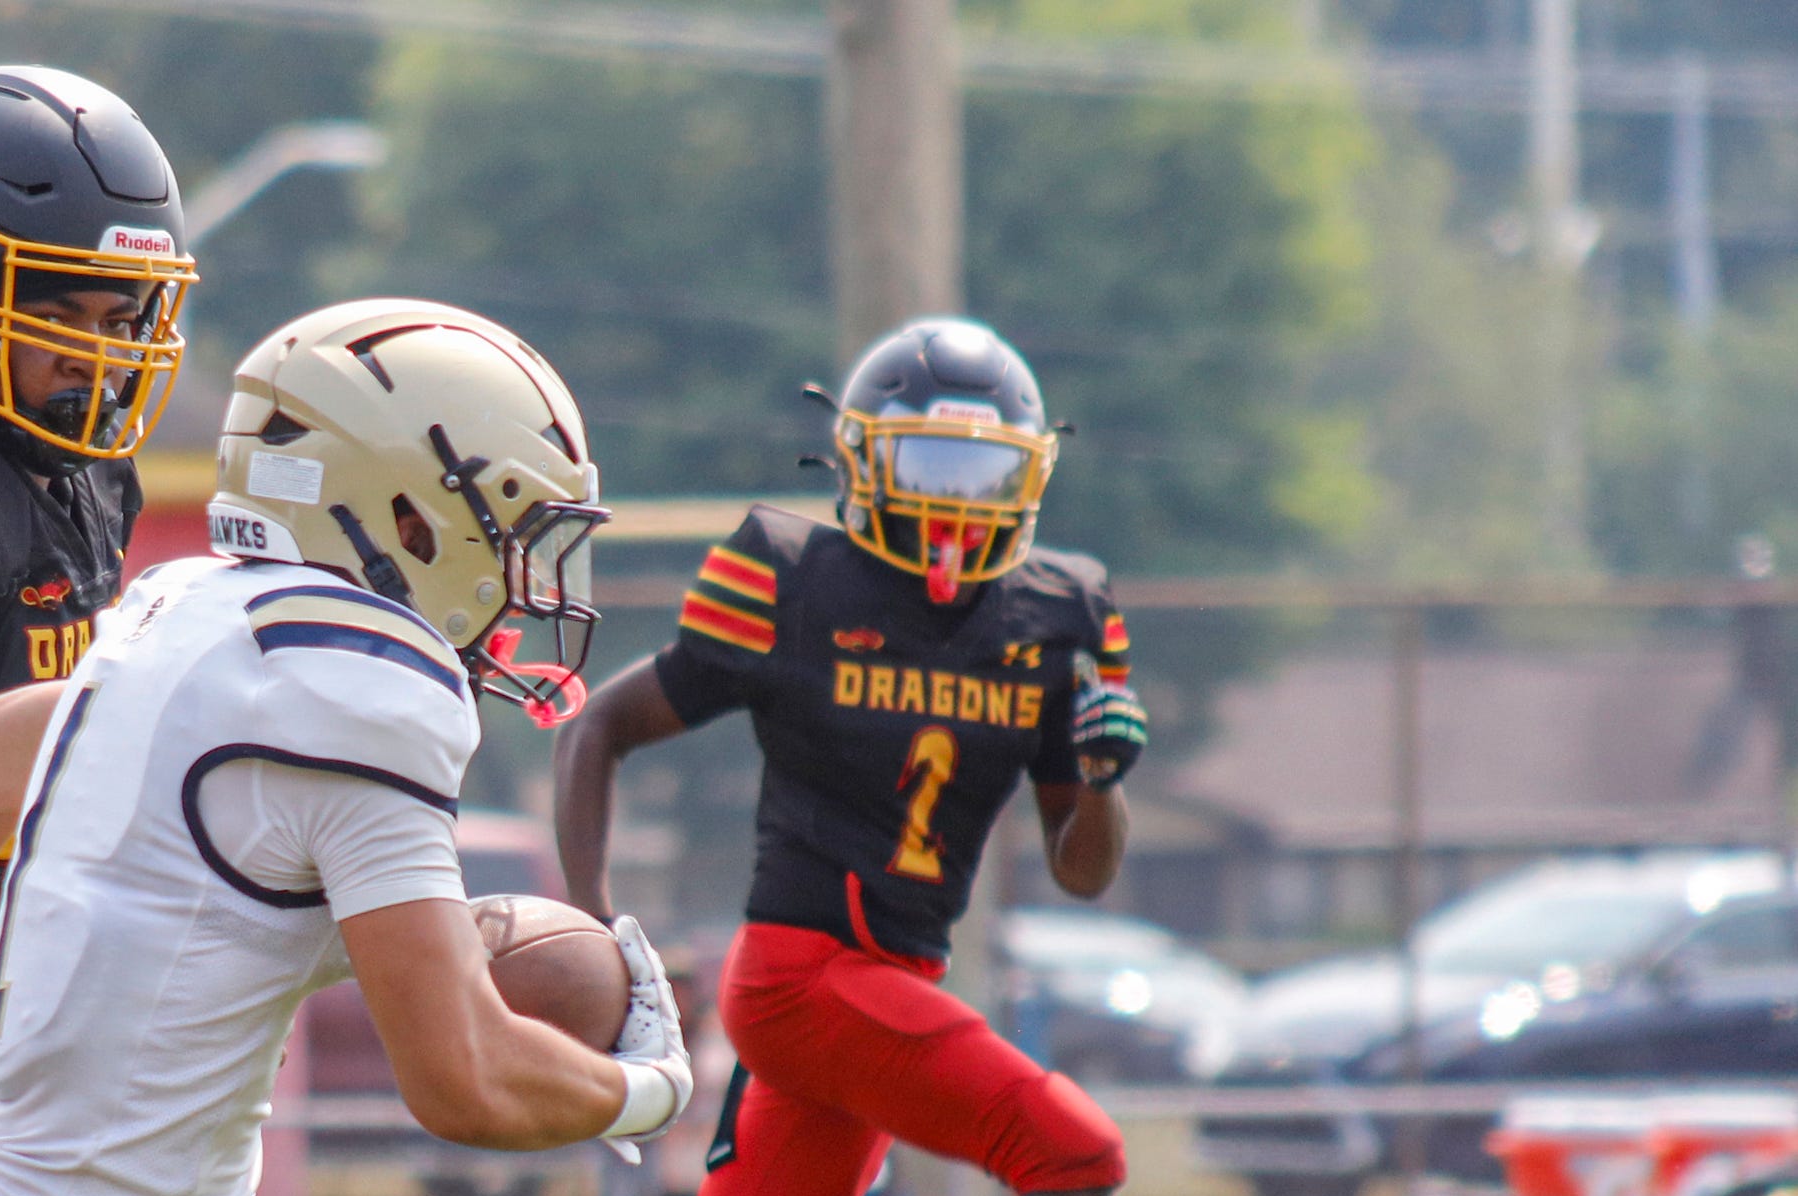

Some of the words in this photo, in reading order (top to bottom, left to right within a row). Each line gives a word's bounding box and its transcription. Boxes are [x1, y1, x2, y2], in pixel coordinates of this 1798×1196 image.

[115, 231, 171, 253] Riddell
[833, 660, 1044, 729] DRAGONS
[885, 724, 959, 885] 2
